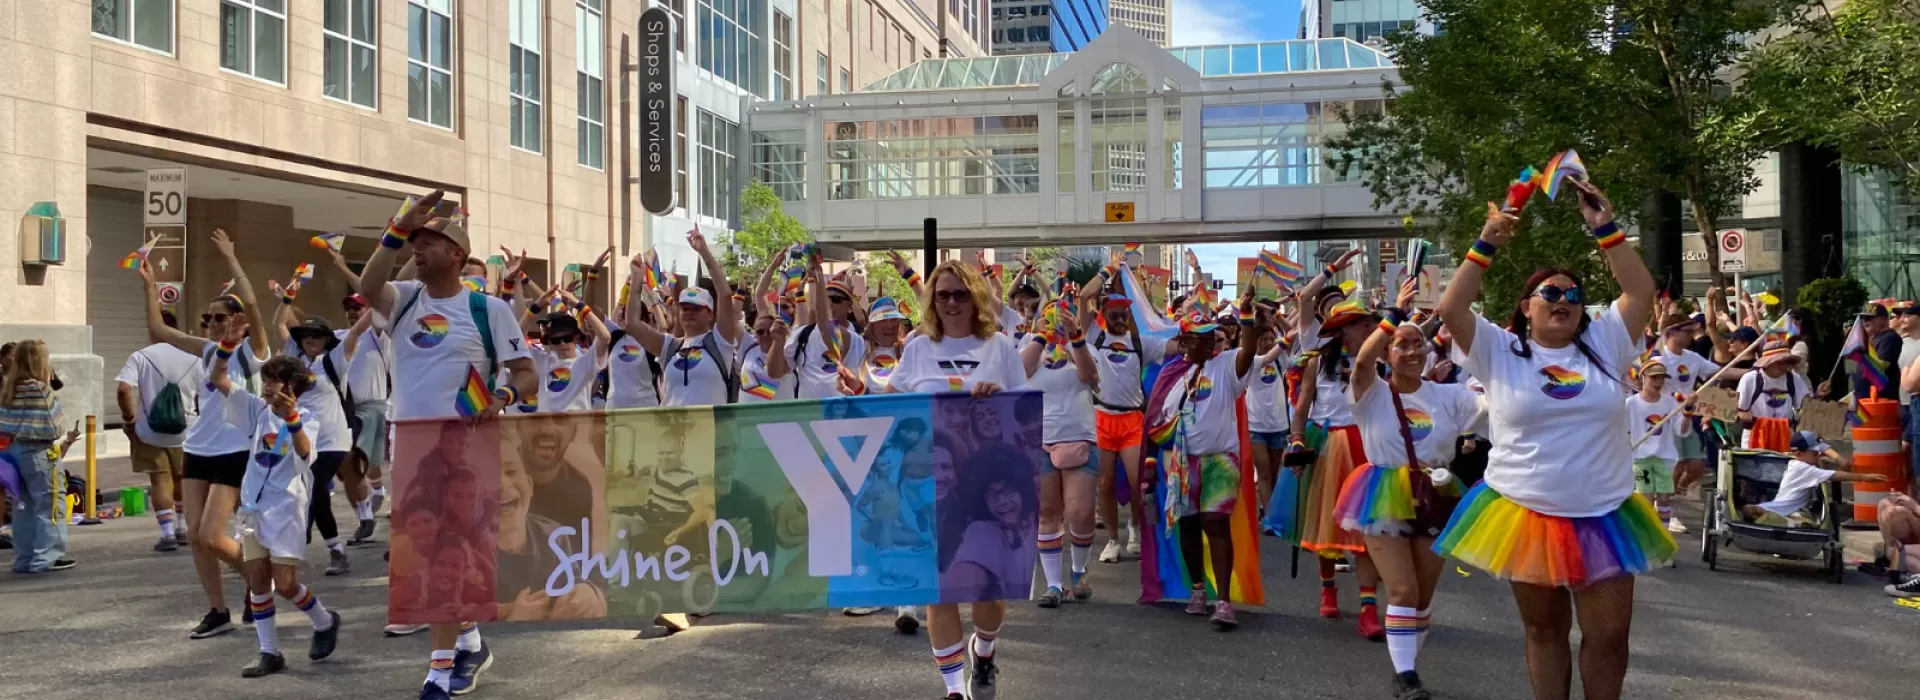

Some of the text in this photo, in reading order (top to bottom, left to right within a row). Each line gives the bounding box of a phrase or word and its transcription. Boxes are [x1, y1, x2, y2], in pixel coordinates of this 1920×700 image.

[644, 21, 664, 172] Shops & Services
[148, 191, 182, 216] 50
[150, 173, 182, 182] MAXIMUM
[756, 415, 895, 577] Y
[545, 517, 769, 597] Shine On
